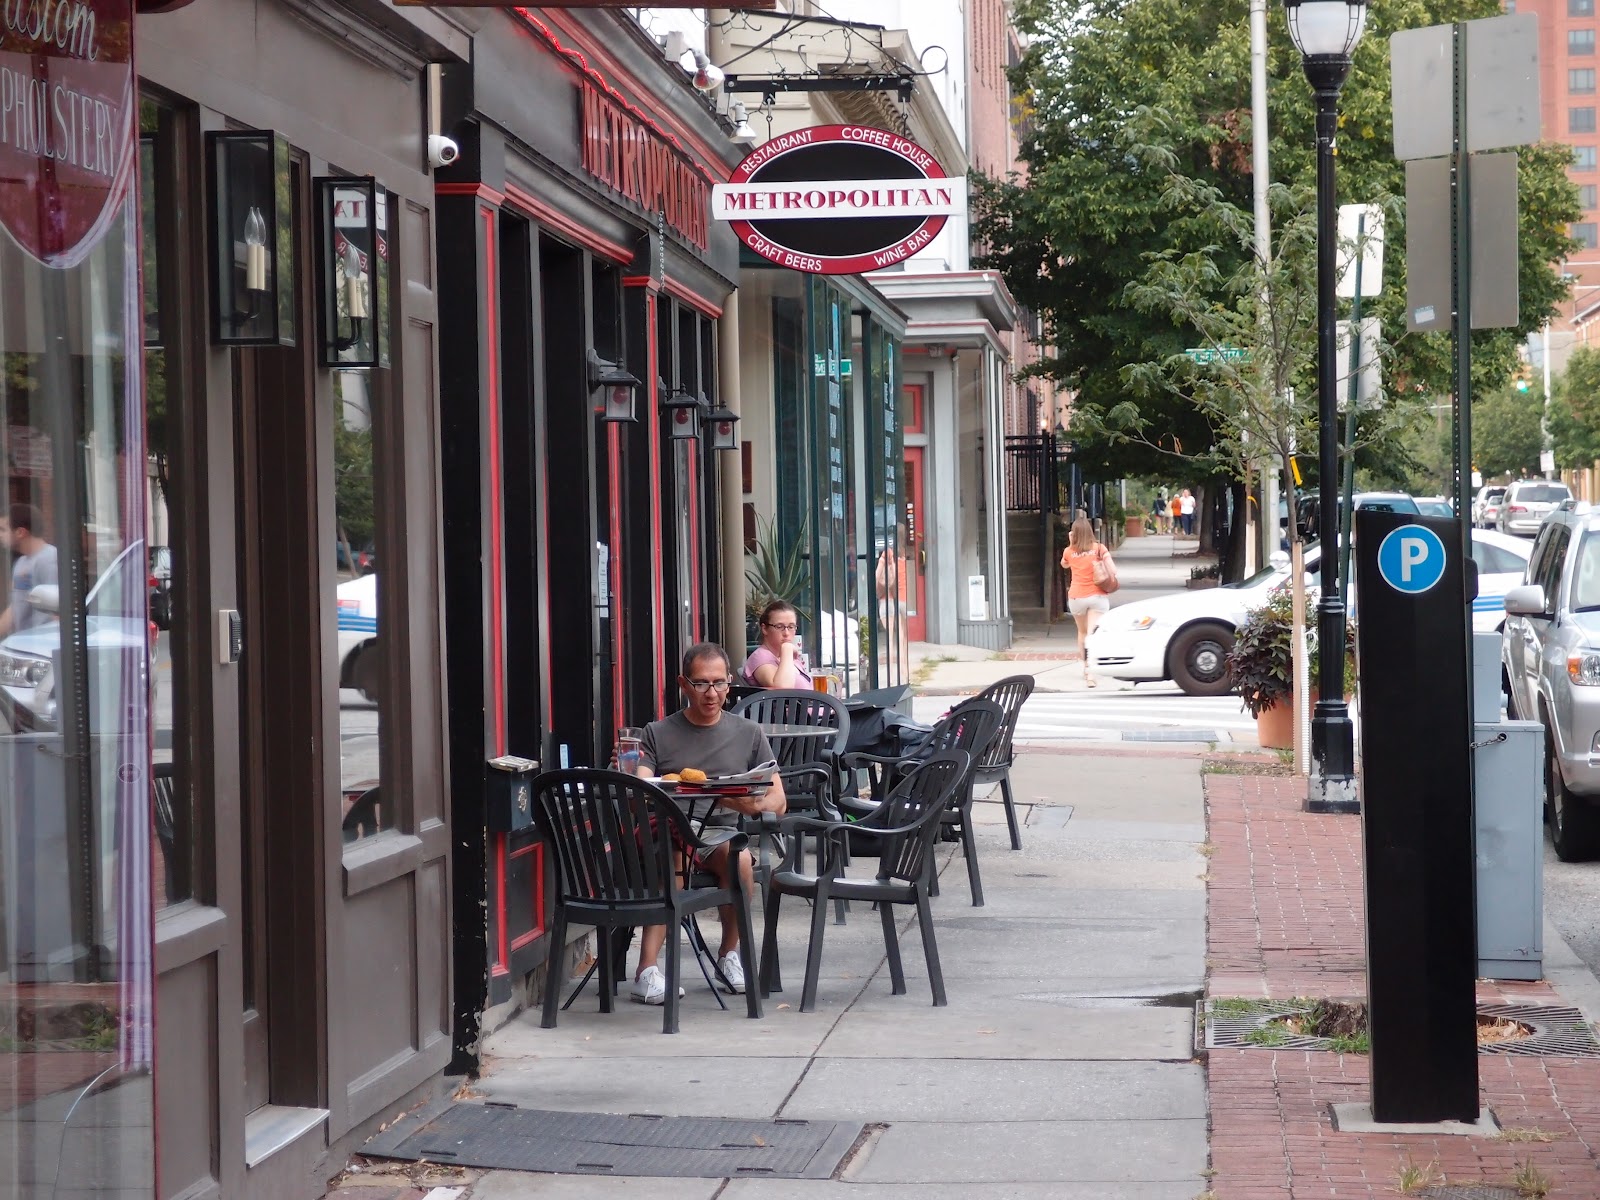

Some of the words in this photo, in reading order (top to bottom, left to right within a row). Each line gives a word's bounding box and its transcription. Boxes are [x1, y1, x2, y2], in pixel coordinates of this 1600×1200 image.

[0, 0, 100, 61] ustom
[0, 66, 117, 178] PHOLSTERY
[581, 78, 709, 253] METROPOLITAN
[741, 130, 813, 174] RESTAURANT
[841, 127, 891, 147] COFFEE
[891, 139, 933, 170] HOUSE
[723, 187, 953, 211] METROPOLITAN
[747, 233, 784, 261] CRAFT
[784, 255, 822, 272] BEERS
[873, 246, 907, 267] WINE
[906, 229, 931, 250] BAR
[1401, 537, 1429, 582] P
